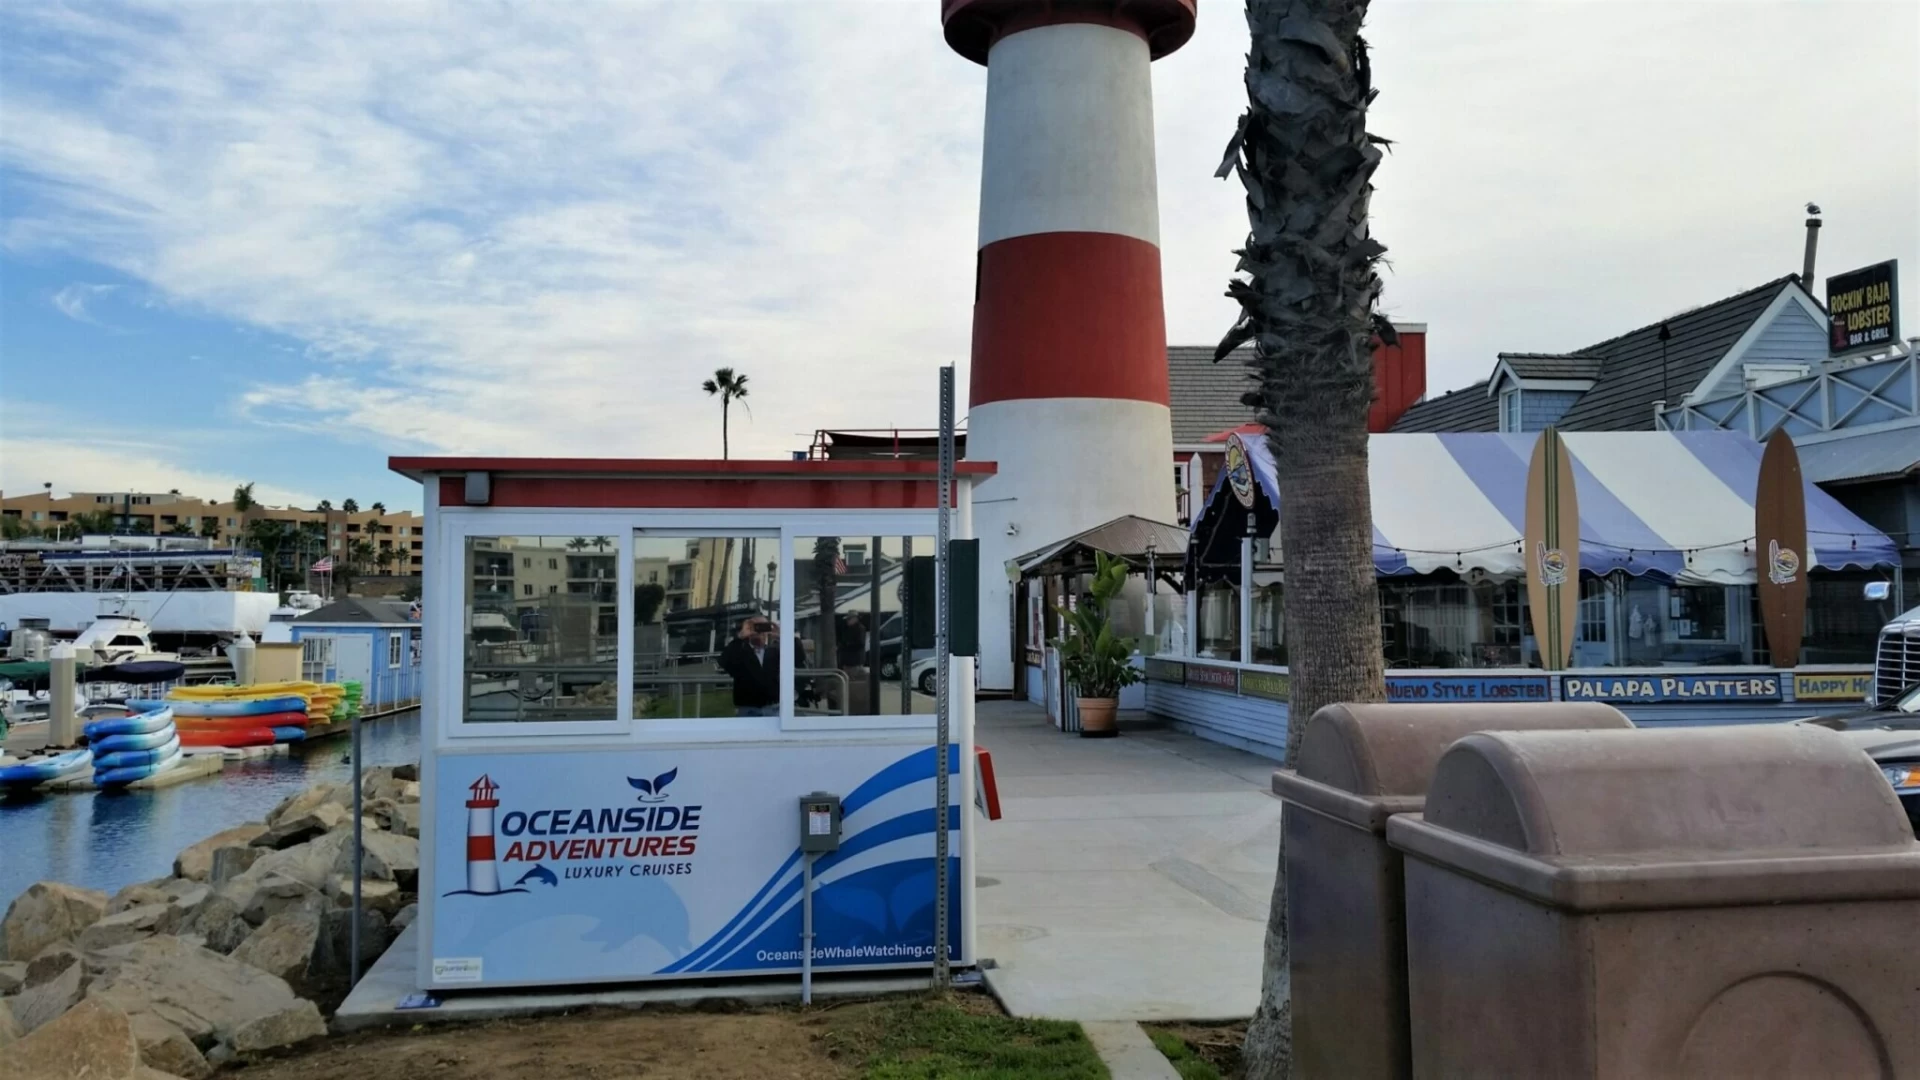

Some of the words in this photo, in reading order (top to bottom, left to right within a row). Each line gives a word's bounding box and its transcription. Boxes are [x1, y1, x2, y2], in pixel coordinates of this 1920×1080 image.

[1866, 281, 1890, 305] BAJA
[1847, 304, 1891, 331] LOBSTER
[1850, 333, 1863, 345] BAR
[1864, 332, 1870, 342] &
[1871, 327, 1889, 341] GRILL
[1432, 681, 1476, 698] STYLE
[1481, 681, 1545, 698] LOBSTER
[1567, 680, 1655, 698] PALAPA
[1661, 678, 1776, 697] PLATTERS
[1799, 679, 1848, 694] HAPPY
[501, 805, 702, 837] OCEANSIDE
[503, 835, 698, 863] ADVENTURES
[565, 865, 624, 879] LUXURY
[630, 862, 692, 877] CRUISES
[756, 944, 952, 962] OceansdeWhaleWatching.c
